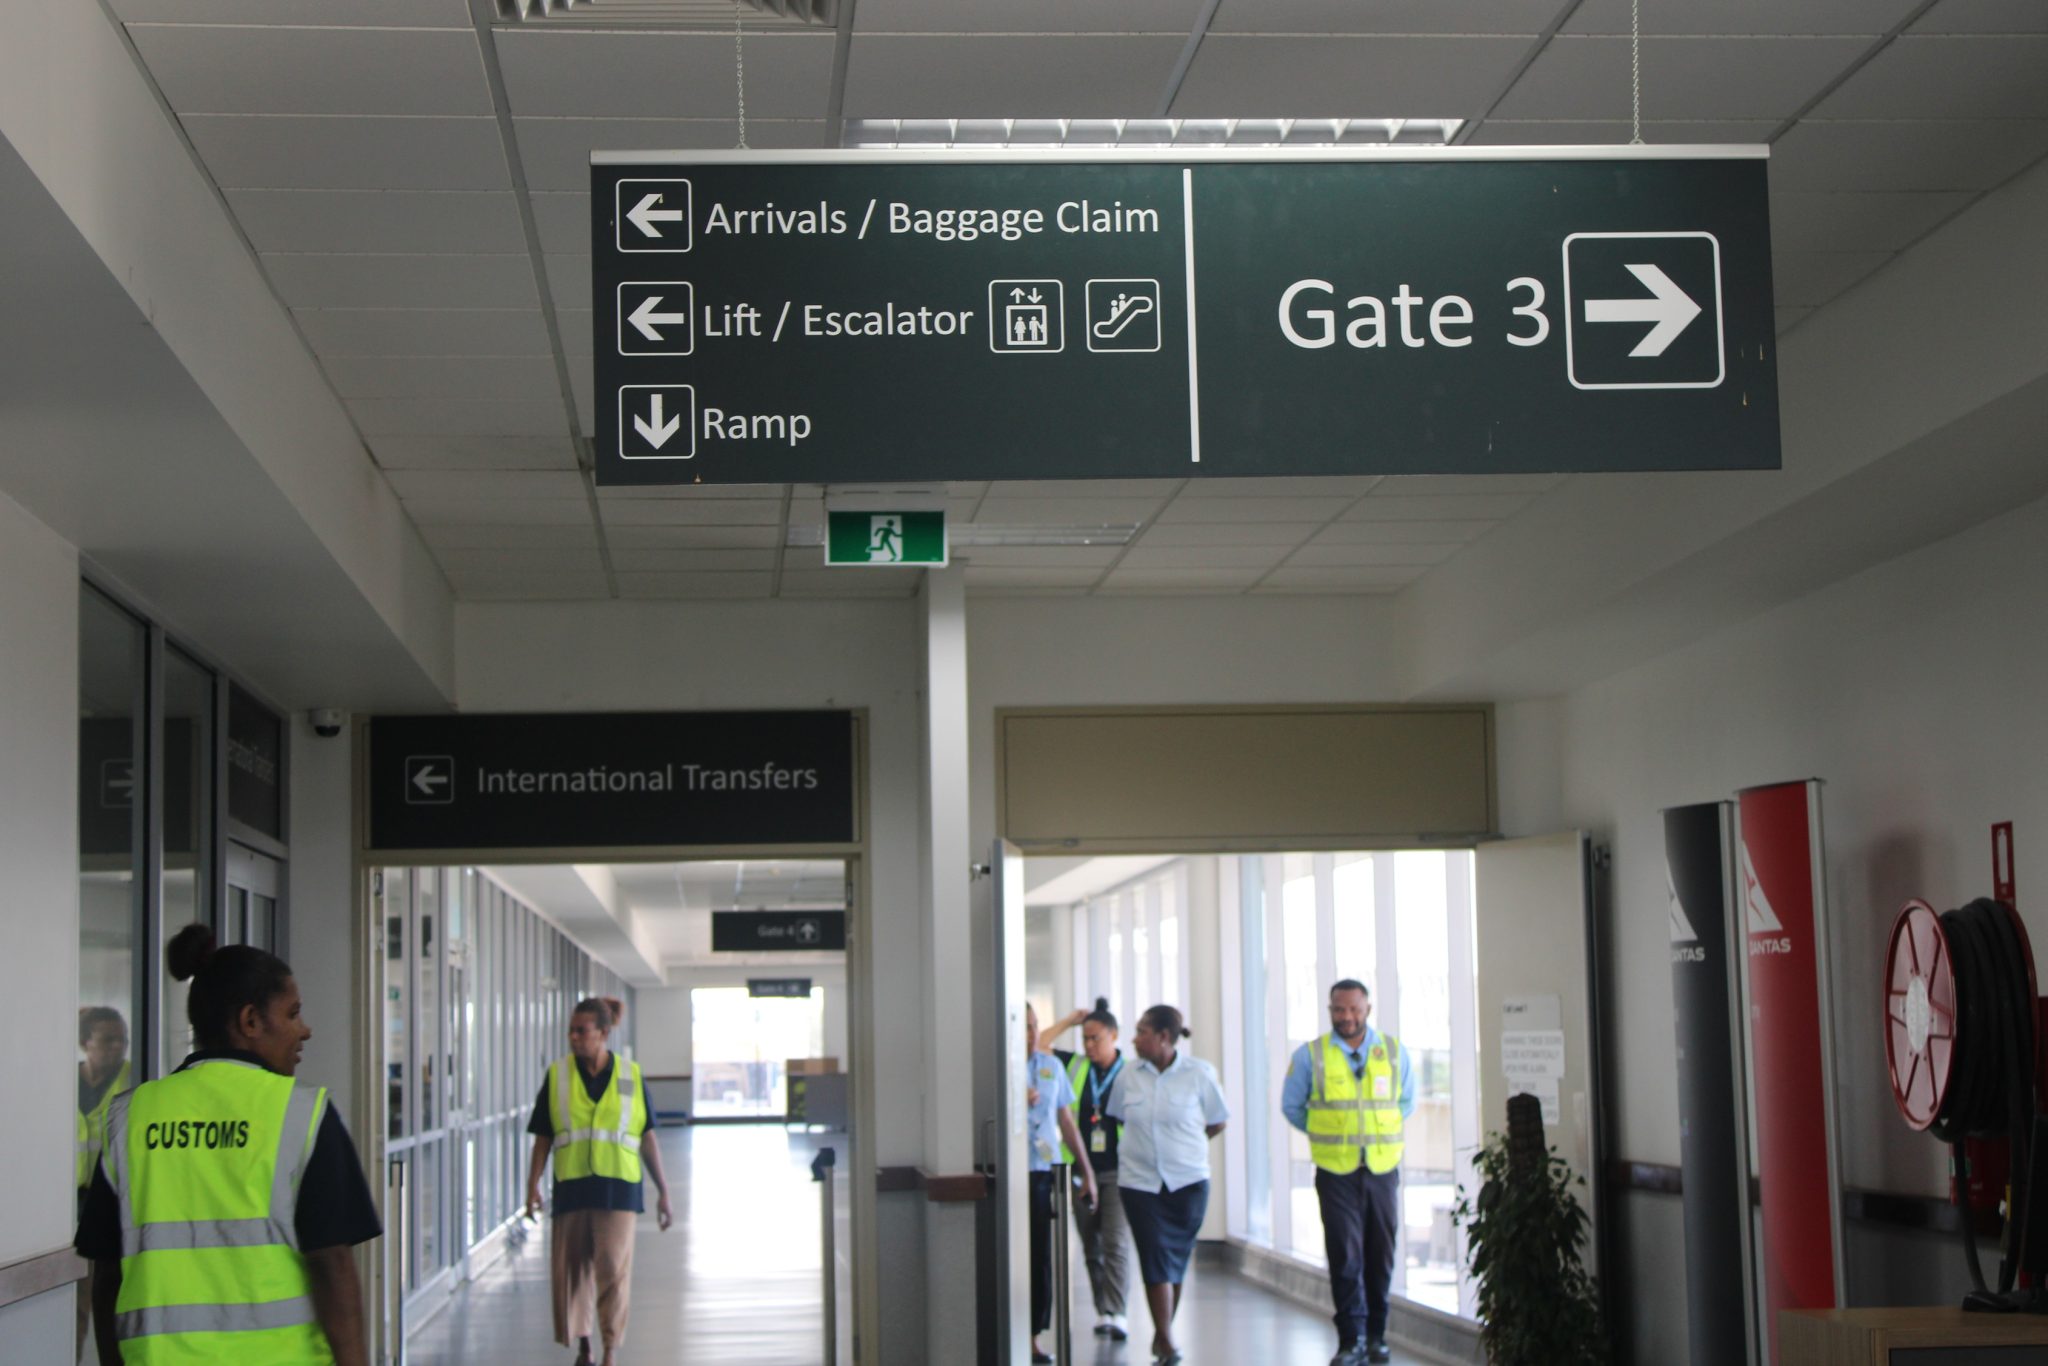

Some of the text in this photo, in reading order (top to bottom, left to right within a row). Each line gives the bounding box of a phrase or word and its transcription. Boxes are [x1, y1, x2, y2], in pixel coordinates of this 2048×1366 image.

[704, 198, 1159, 242] Arrivals / Baggage Claim
[705, 301, 974, 342] Lift / Escalator
[1278, 276, 1550, 349] Gate 3
[704, 408, 811, 447] Ramp
[478, 762, 818, 793] International Transfers
[757, 924, 784, 938] Gate
[145, 1120, 249, 1150] CUSTOMS
